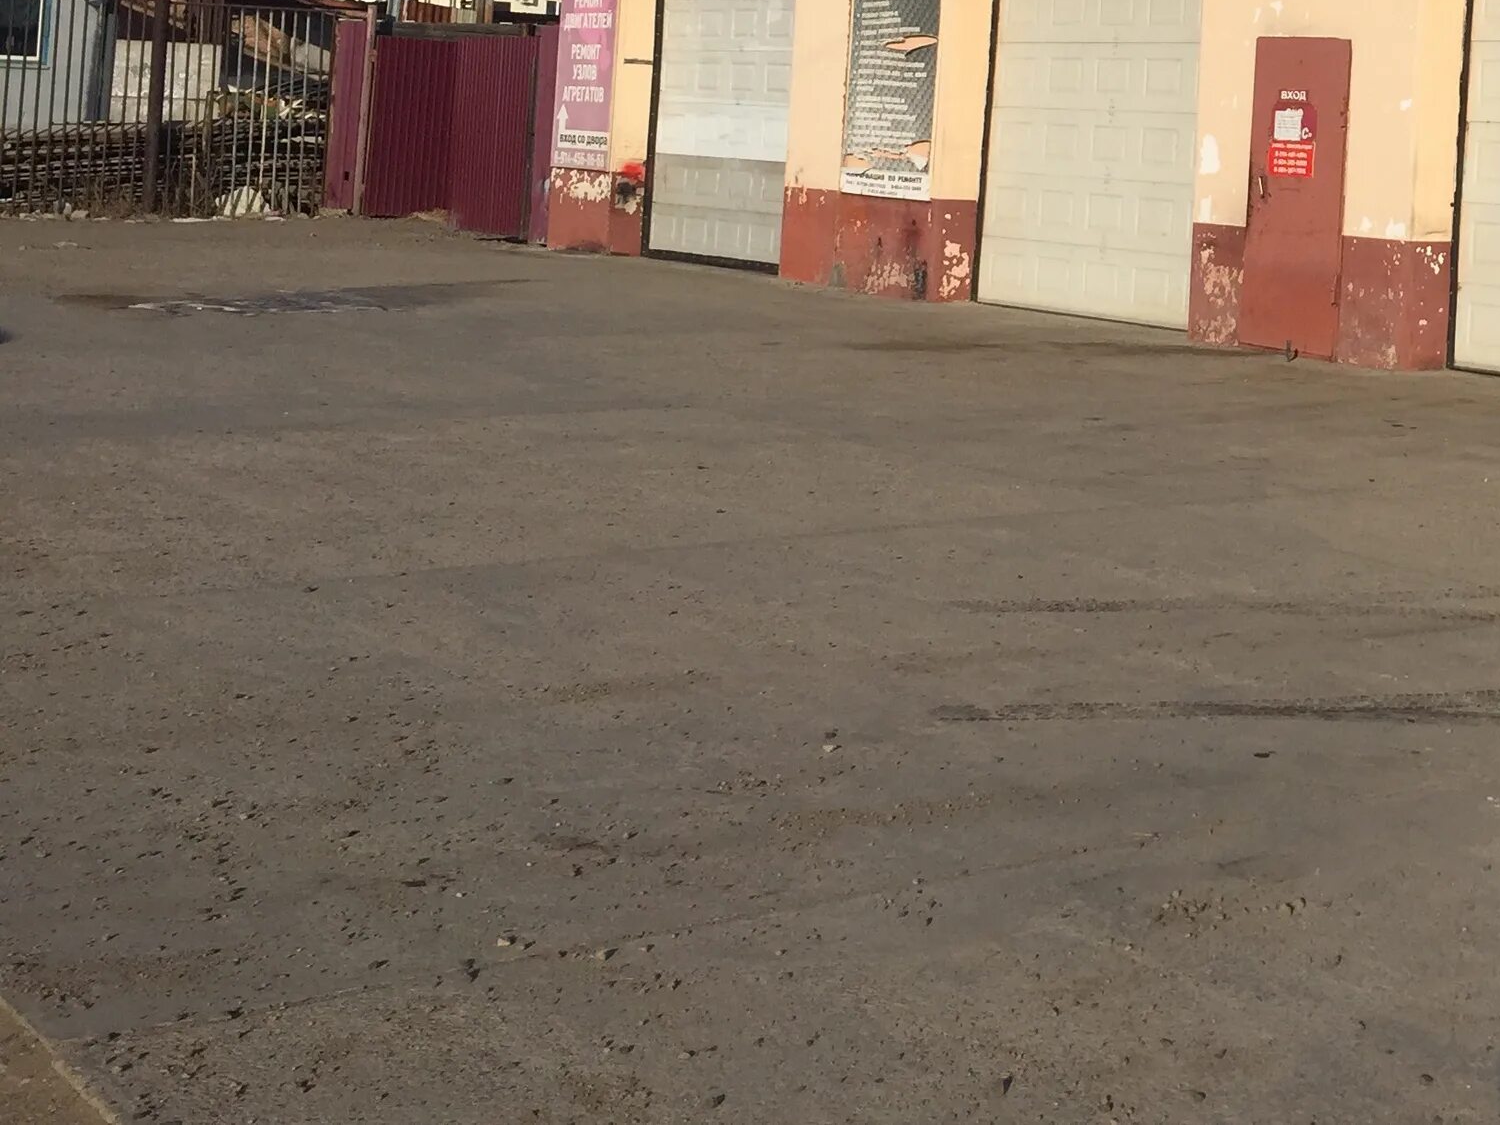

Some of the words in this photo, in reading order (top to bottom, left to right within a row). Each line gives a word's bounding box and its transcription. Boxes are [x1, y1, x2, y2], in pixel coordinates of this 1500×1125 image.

[564, 10, 613, 31] ДВИГАТЕЛЕЙ
[571, 43, 601, 60] РЕМОНТ
[572, 64, 597, 80] УЗЛОВ
[562, 85, 604, 103] АГРЕГАТОВ
[1280, 90, 1307, 101] ВХОД
